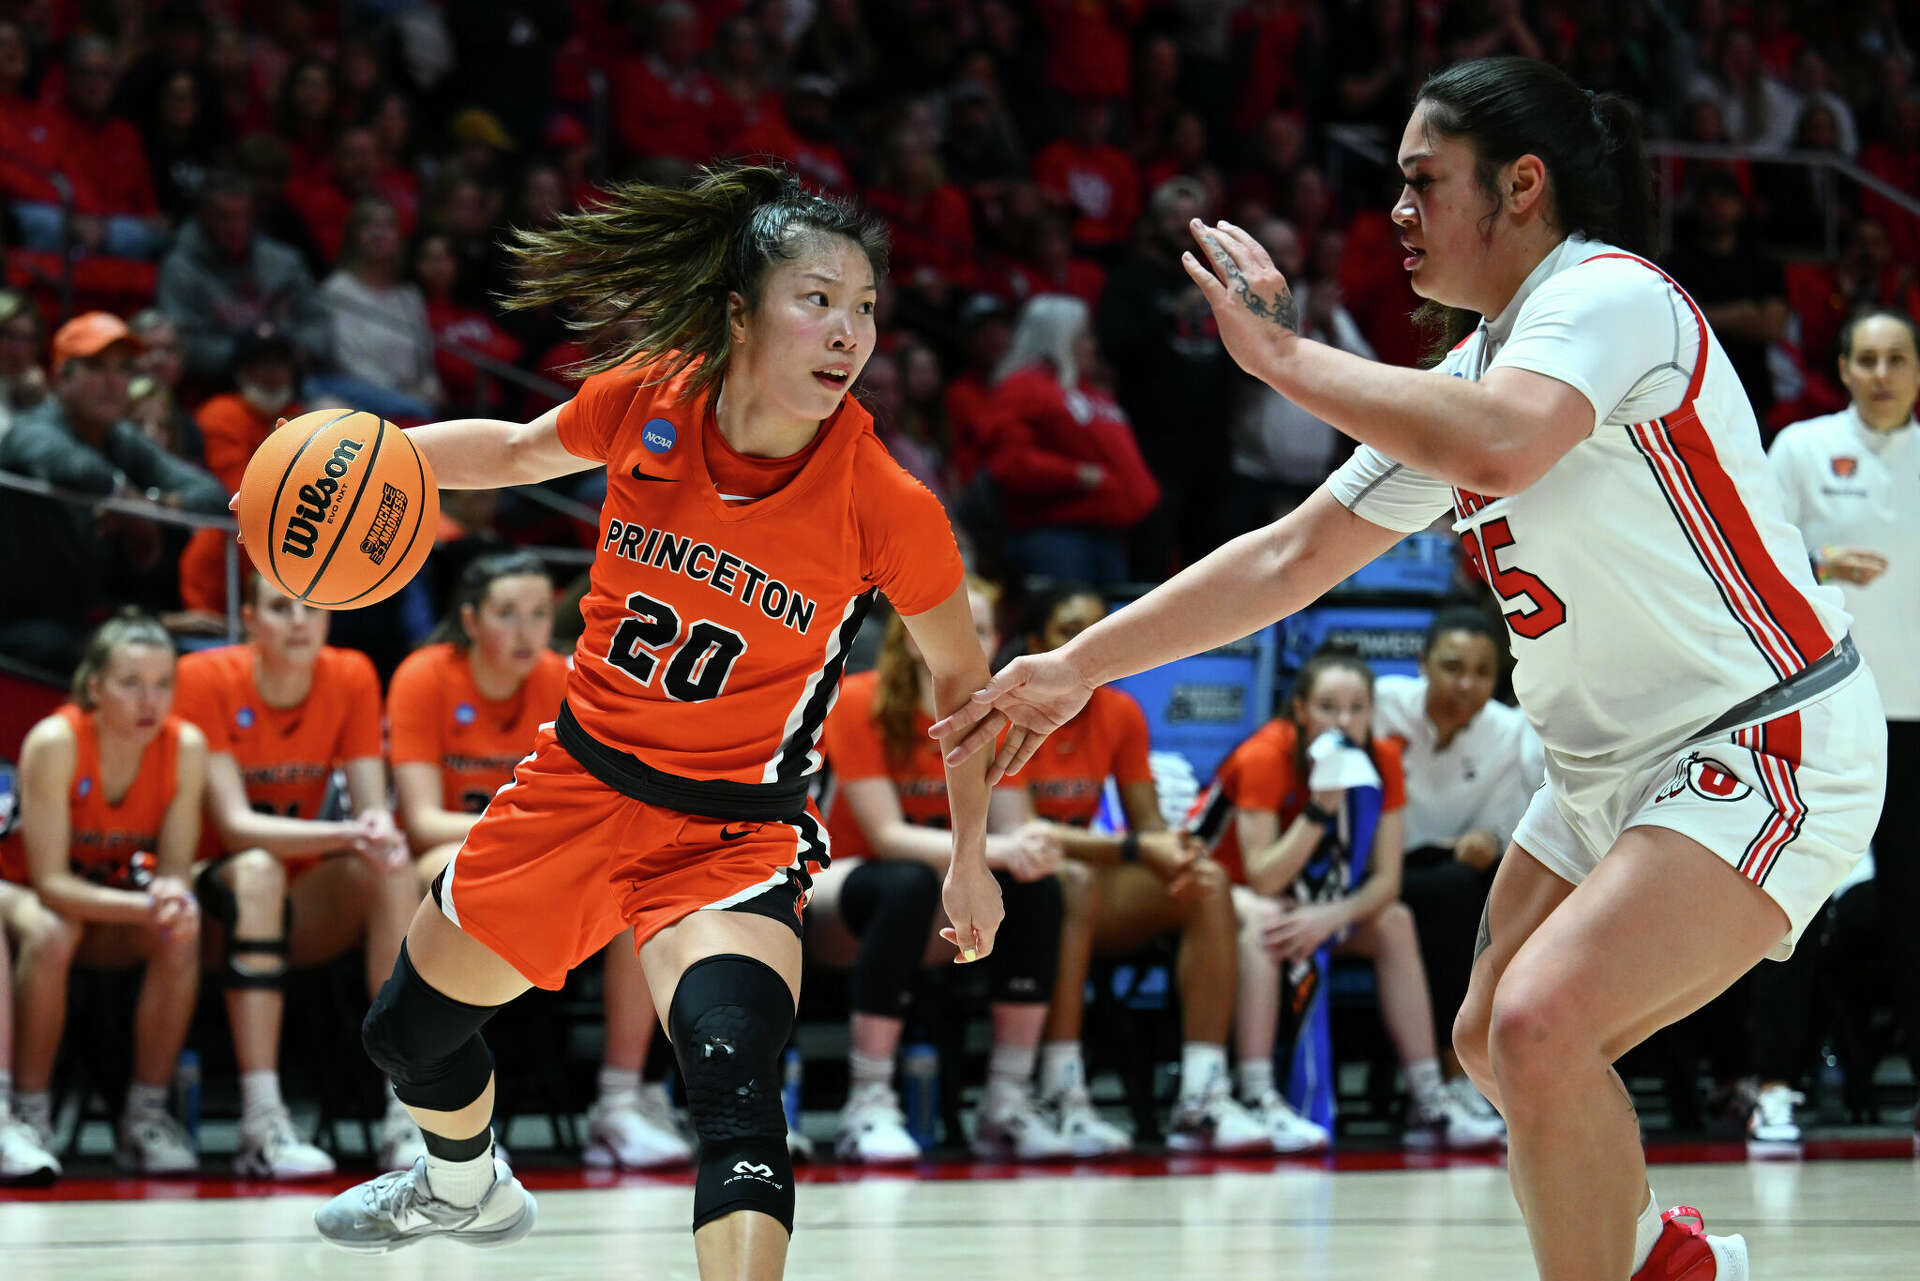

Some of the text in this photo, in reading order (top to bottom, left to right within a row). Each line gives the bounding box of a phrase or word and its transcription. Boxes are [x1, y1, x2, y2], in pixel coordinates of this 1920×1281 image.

[644, 431, 672, 449] NCAA
[281, 438, 364, 559] Wilson
[327, 483, 348, 524] EVO NXT
[367, 503, 391, 544] MARCH
[380, 490, 405, 545] MADNESS
[603, 517, 817, 635] PRINCETON
[602, 591, 748, 703] 20
